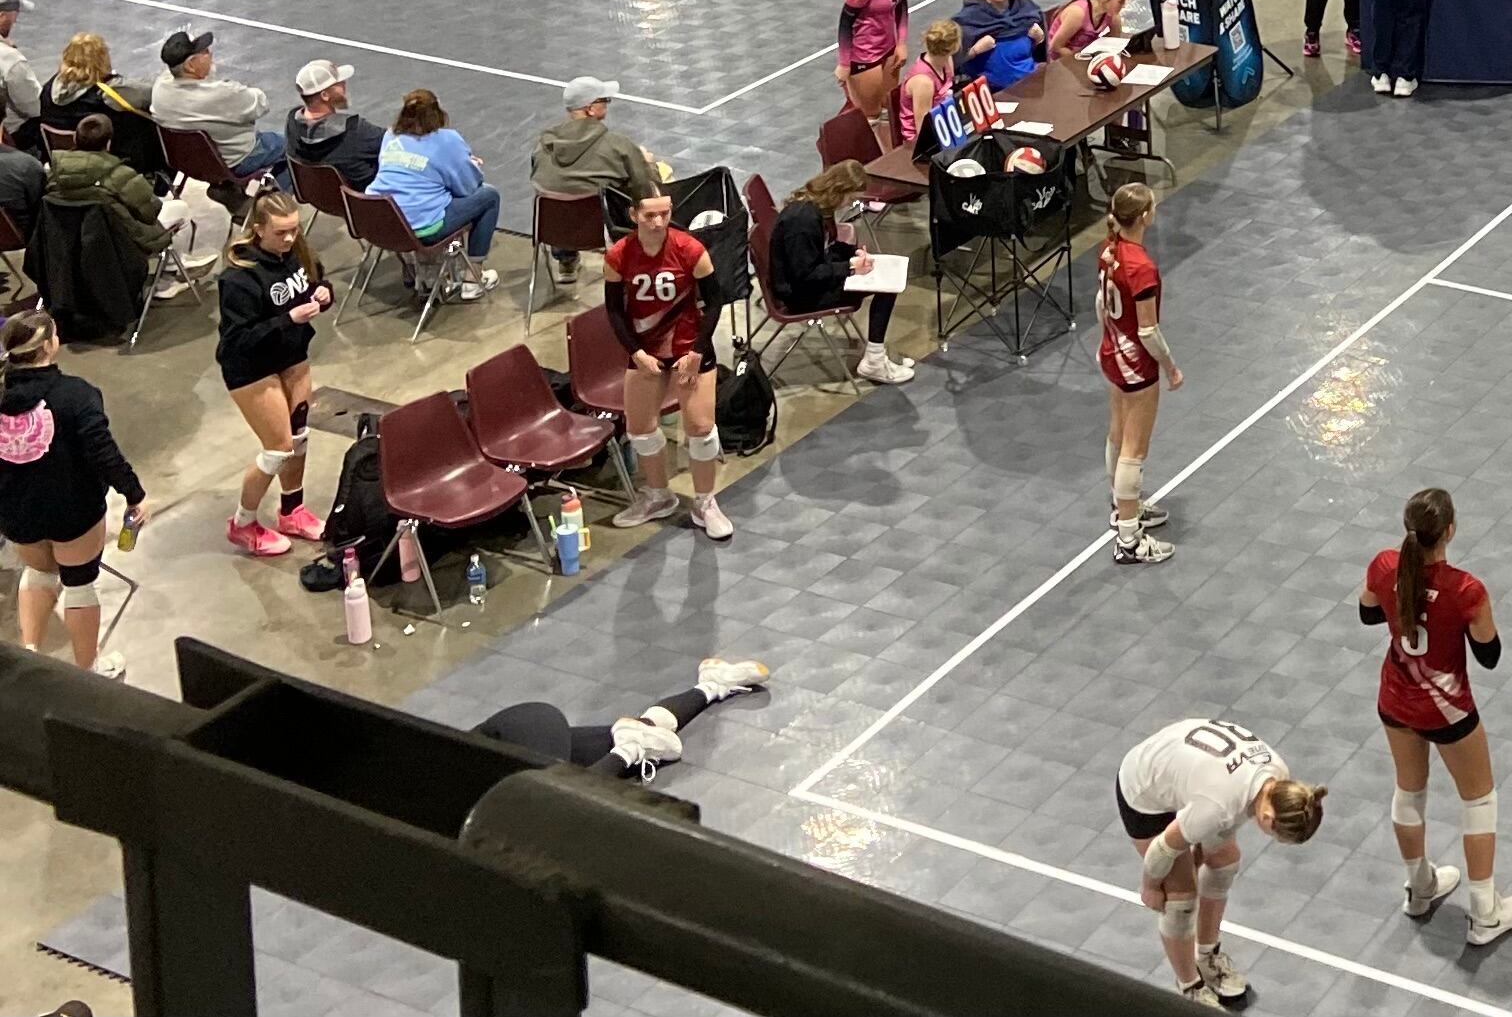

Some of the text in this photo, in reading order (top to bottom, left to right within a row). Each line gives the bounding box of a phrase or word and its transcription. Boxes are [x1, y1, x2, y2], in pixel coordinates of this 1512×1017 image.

[1180, 9, 1201, 24] ARE
[934, 104, 963, 148] 00
[967, 83, 996, 125] 00
[631, 271, 677, 302] 26
